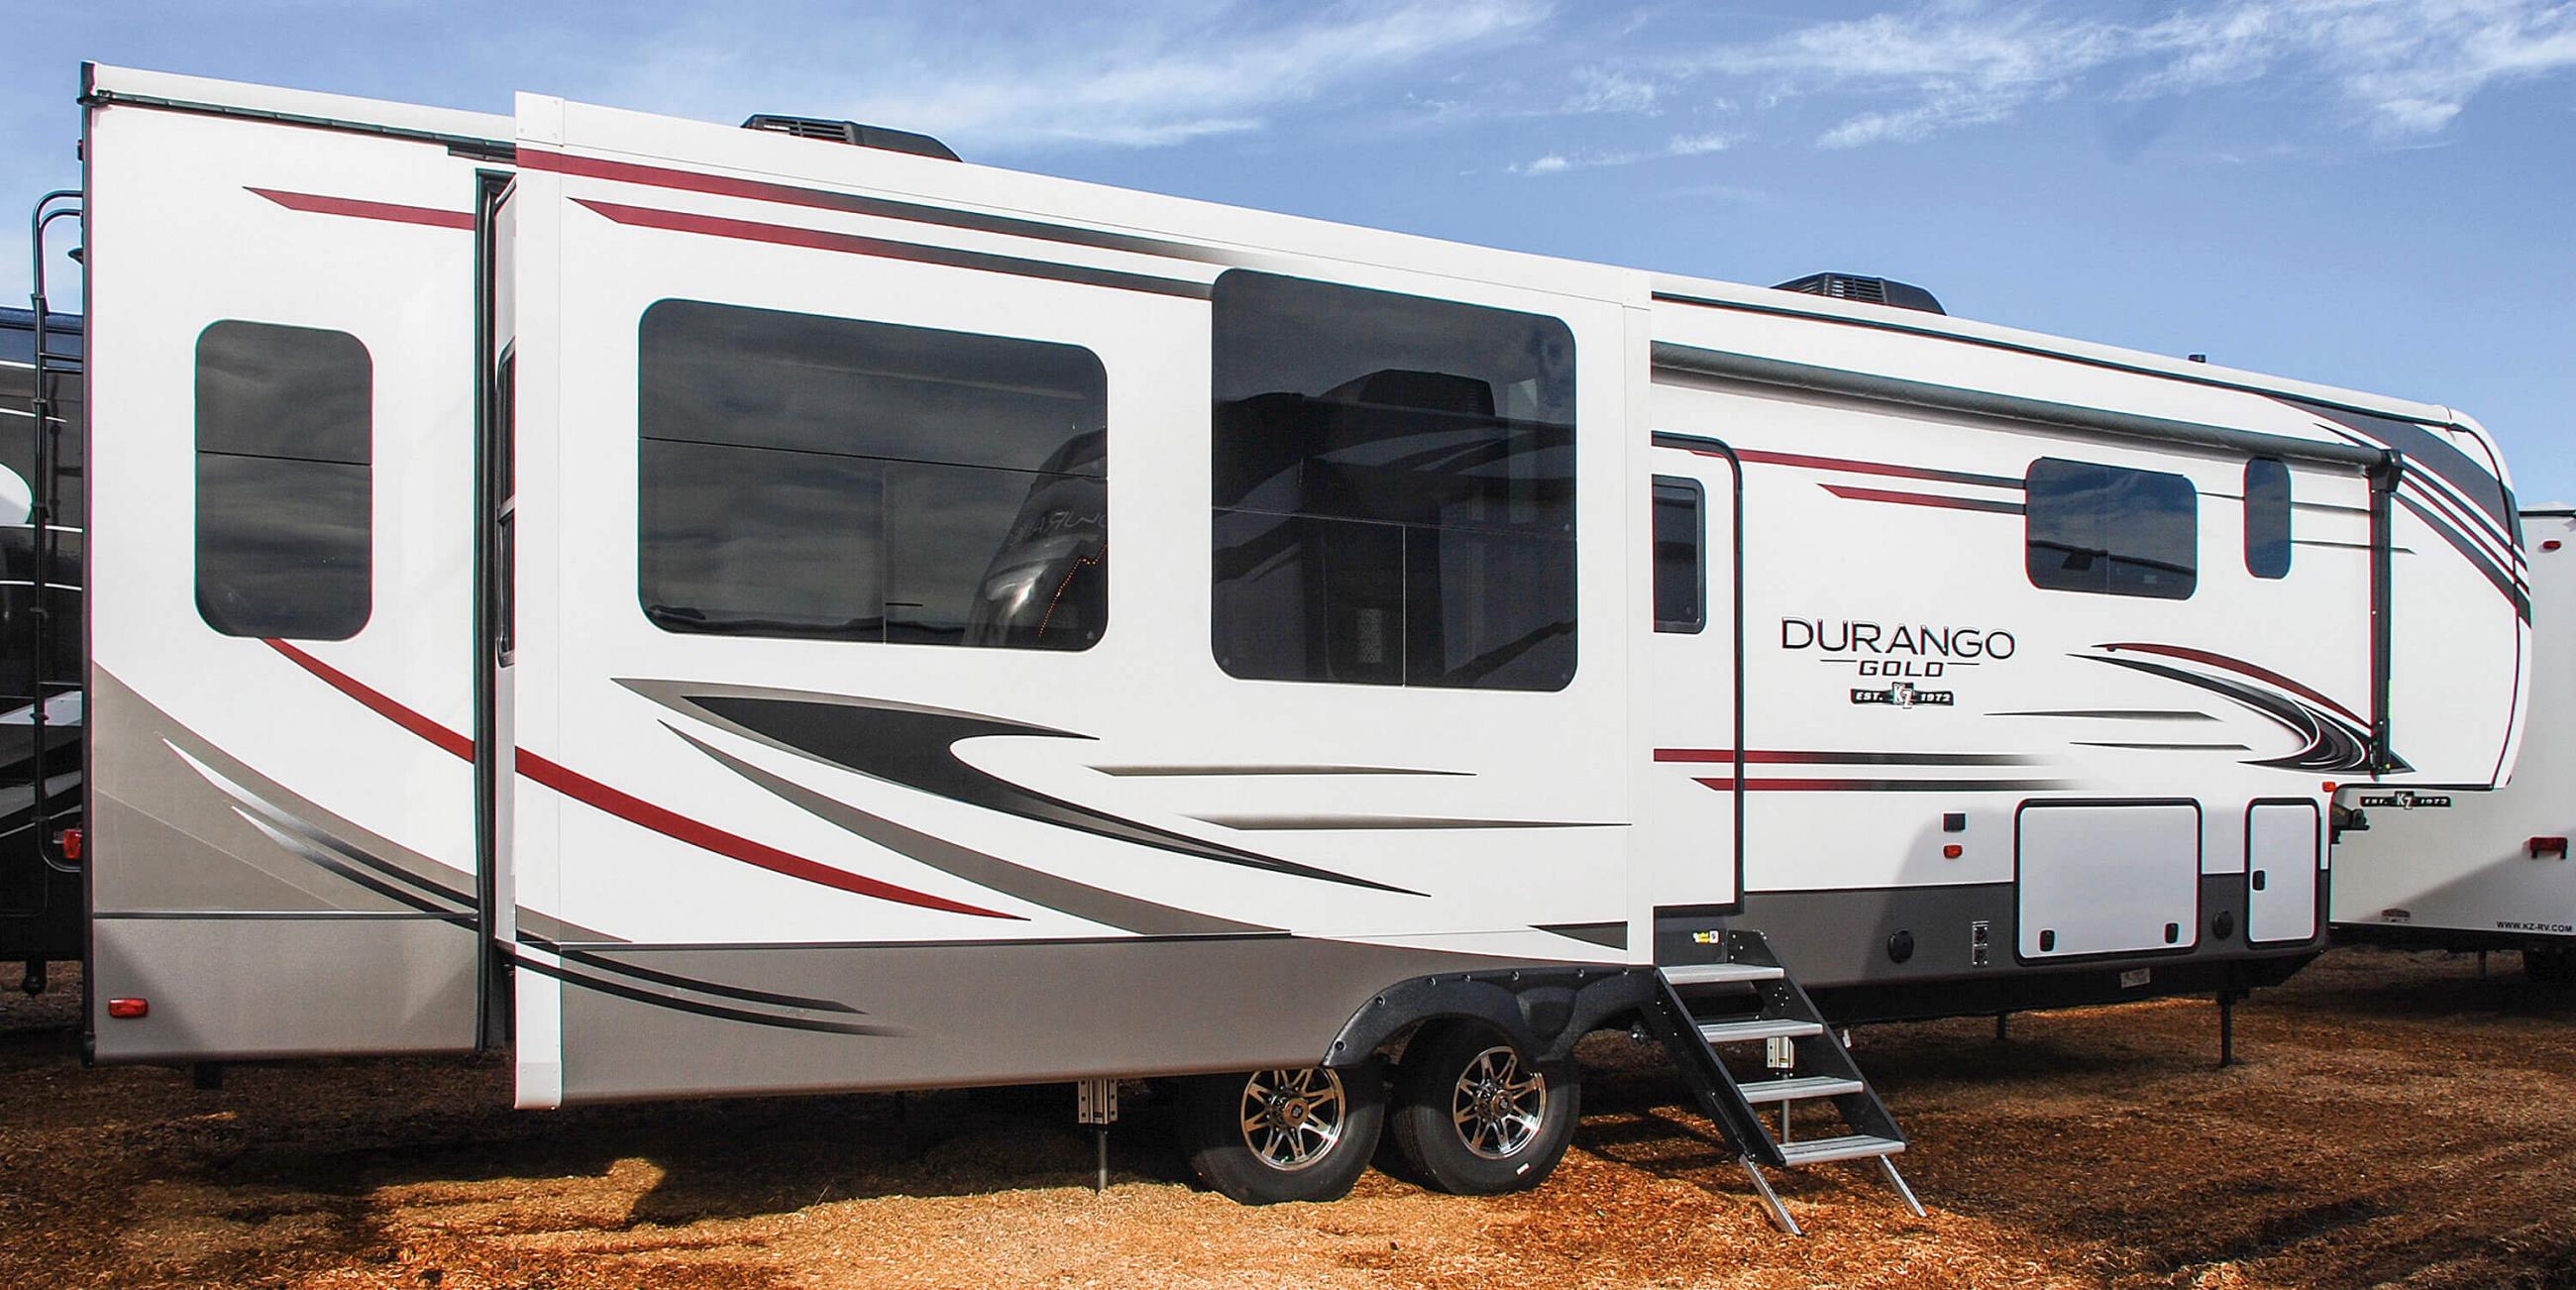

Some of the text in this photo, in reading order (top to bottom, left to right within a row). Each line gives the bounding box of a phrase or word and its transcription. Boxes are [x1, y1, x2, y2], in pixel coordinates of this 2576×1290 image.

[1781, 616, 2016, 661] DURANGO
[1859, 660, 1944, 678] GOLD
[1856, 682, 1951, 709] EST. KZ 1972
[2396, 793, 2413, 809] KZ
[2496, 920, 2572, 932] WWW.KZ-RV.COM
